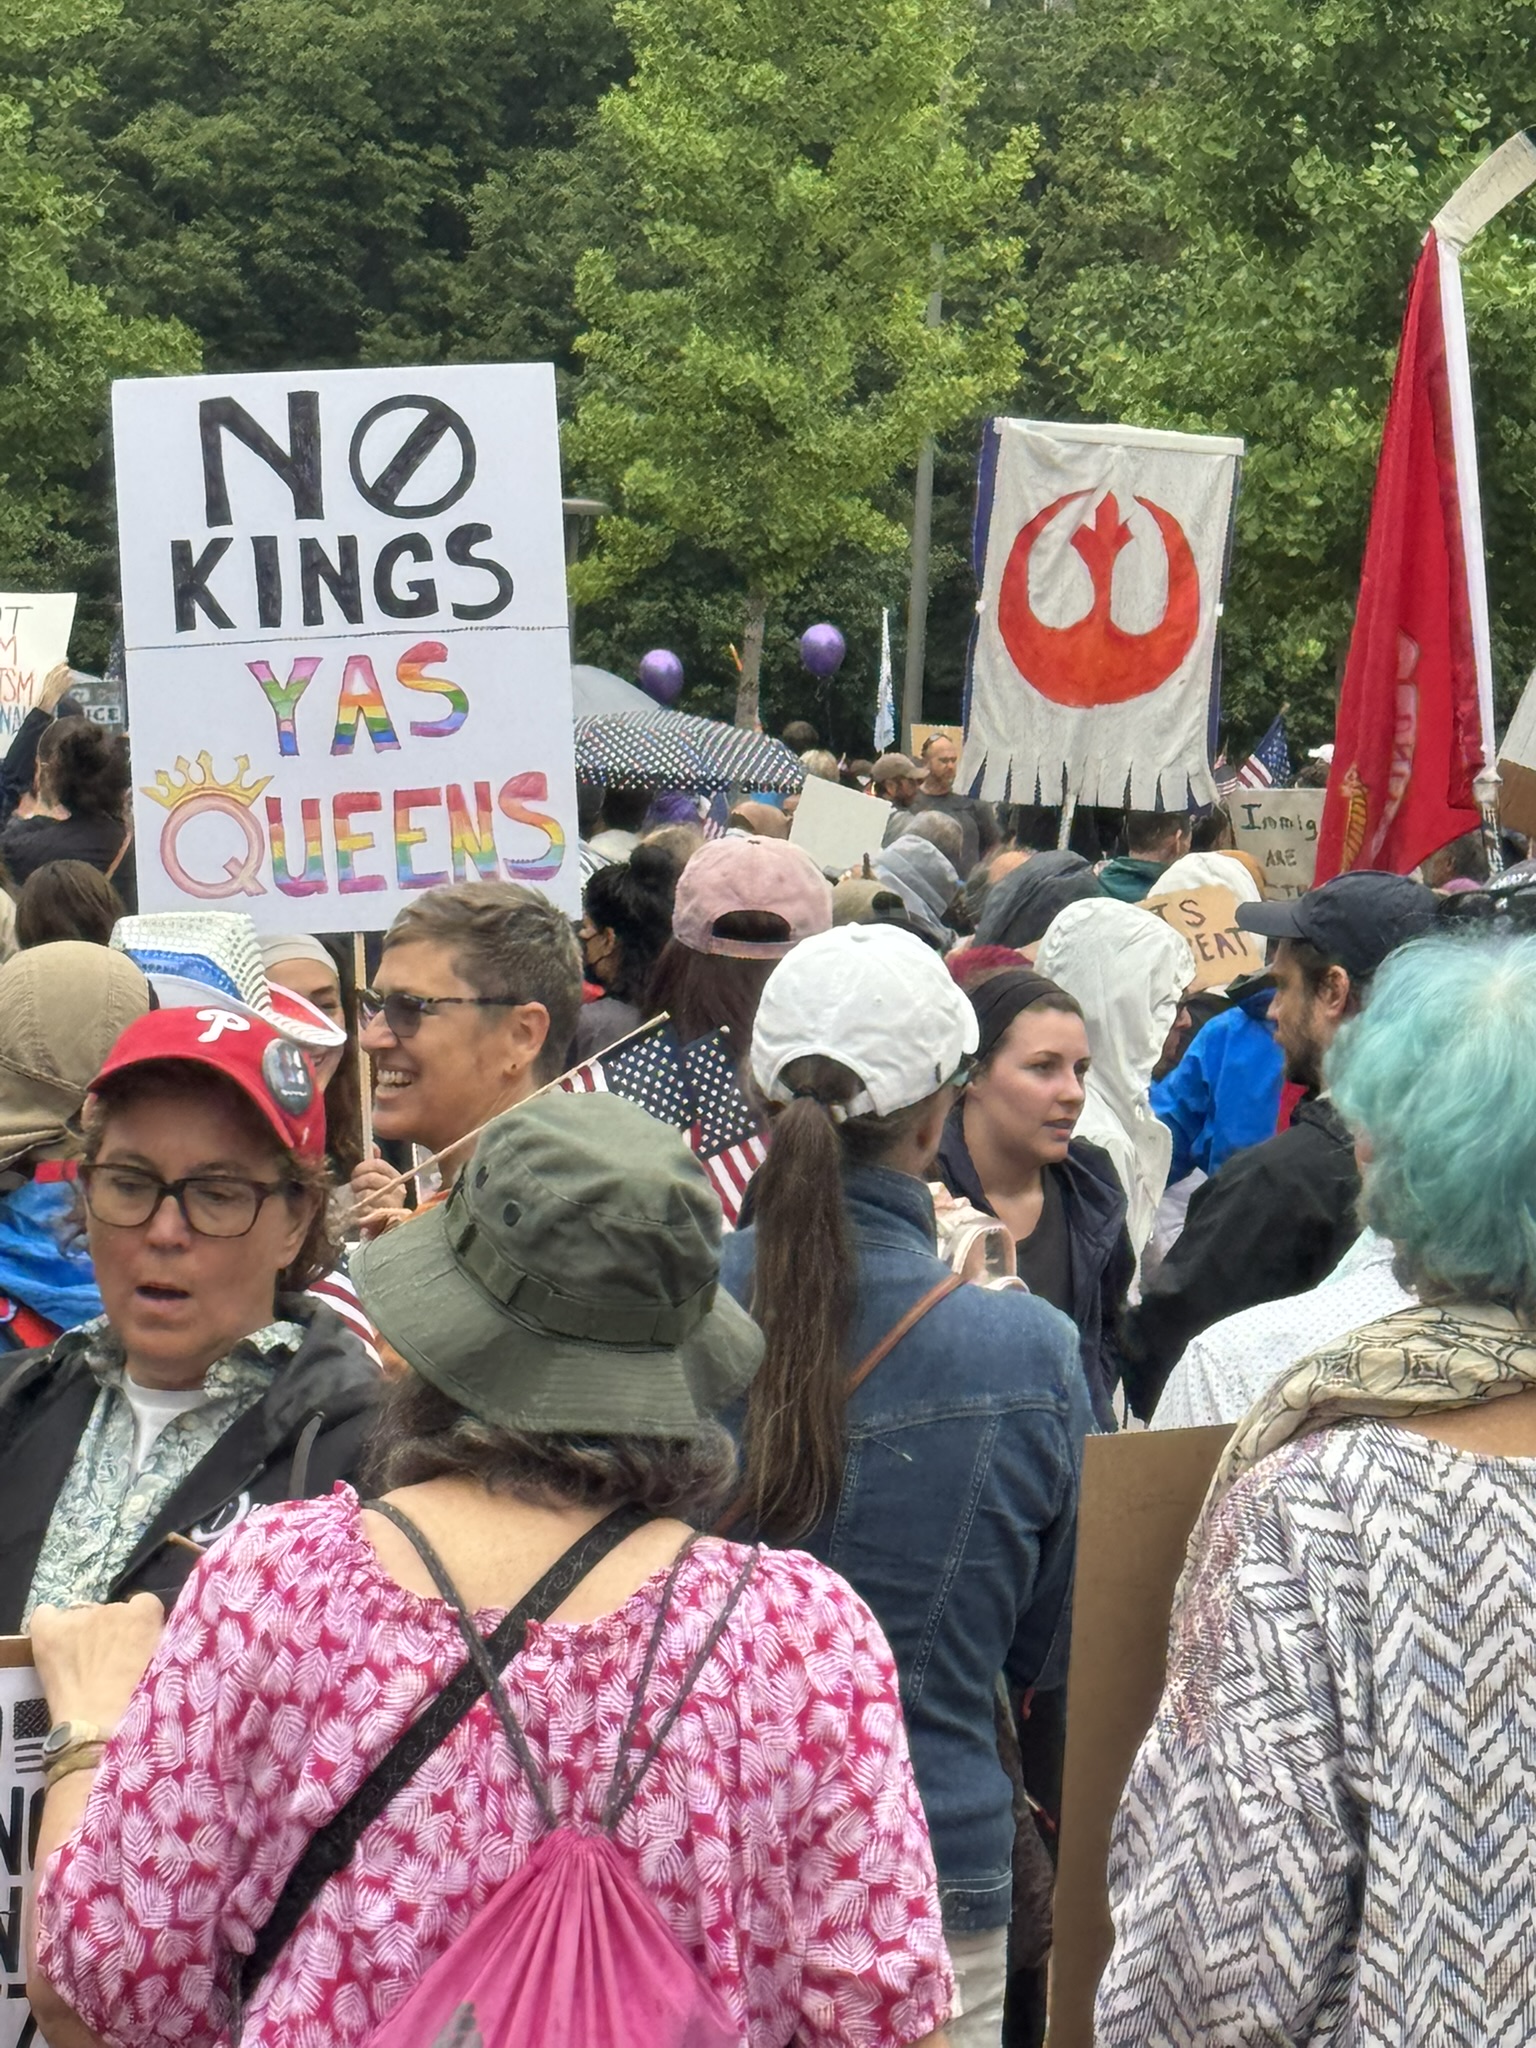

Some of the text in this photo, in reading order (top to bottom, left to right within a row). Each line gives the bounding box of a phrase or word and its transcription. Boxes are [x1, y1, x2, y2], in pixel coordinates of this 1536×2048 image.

[171, 522, 514, 633] KINGS
[245, 641, 469, 757] YAS
[160, 771, 565, 899] QUEENS
[1265, 849, 1297, 867] ARE
[1187, 927, 1248, 961] EAT
[196, 1008, 251, 1043] P
